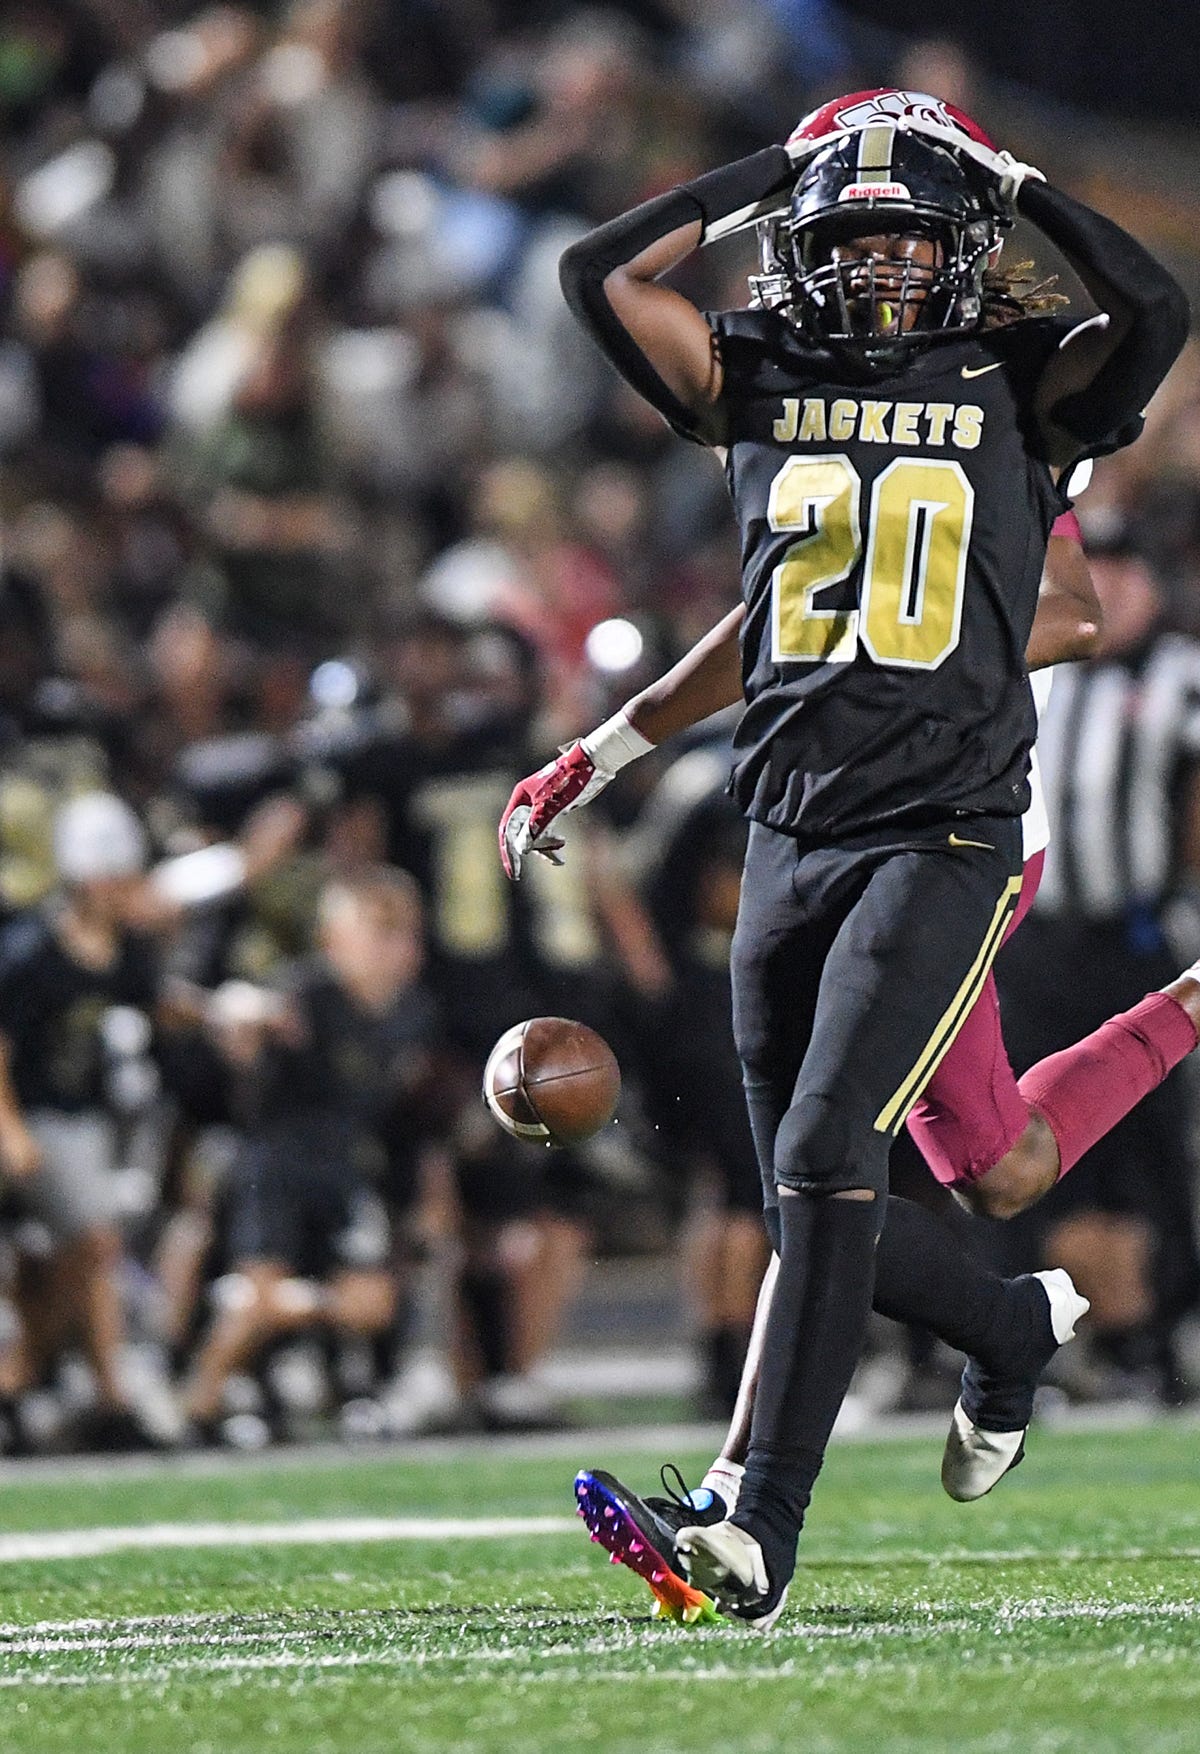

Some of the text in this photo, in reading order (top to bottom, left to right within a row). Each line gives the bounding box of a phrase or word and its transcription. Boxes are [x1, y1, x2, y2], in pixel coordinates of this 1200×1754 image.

[848, 186, 901, 198] Riddell
[772, 398, 985, 451] JACKETS
[767, 453, 976, 672] 20
